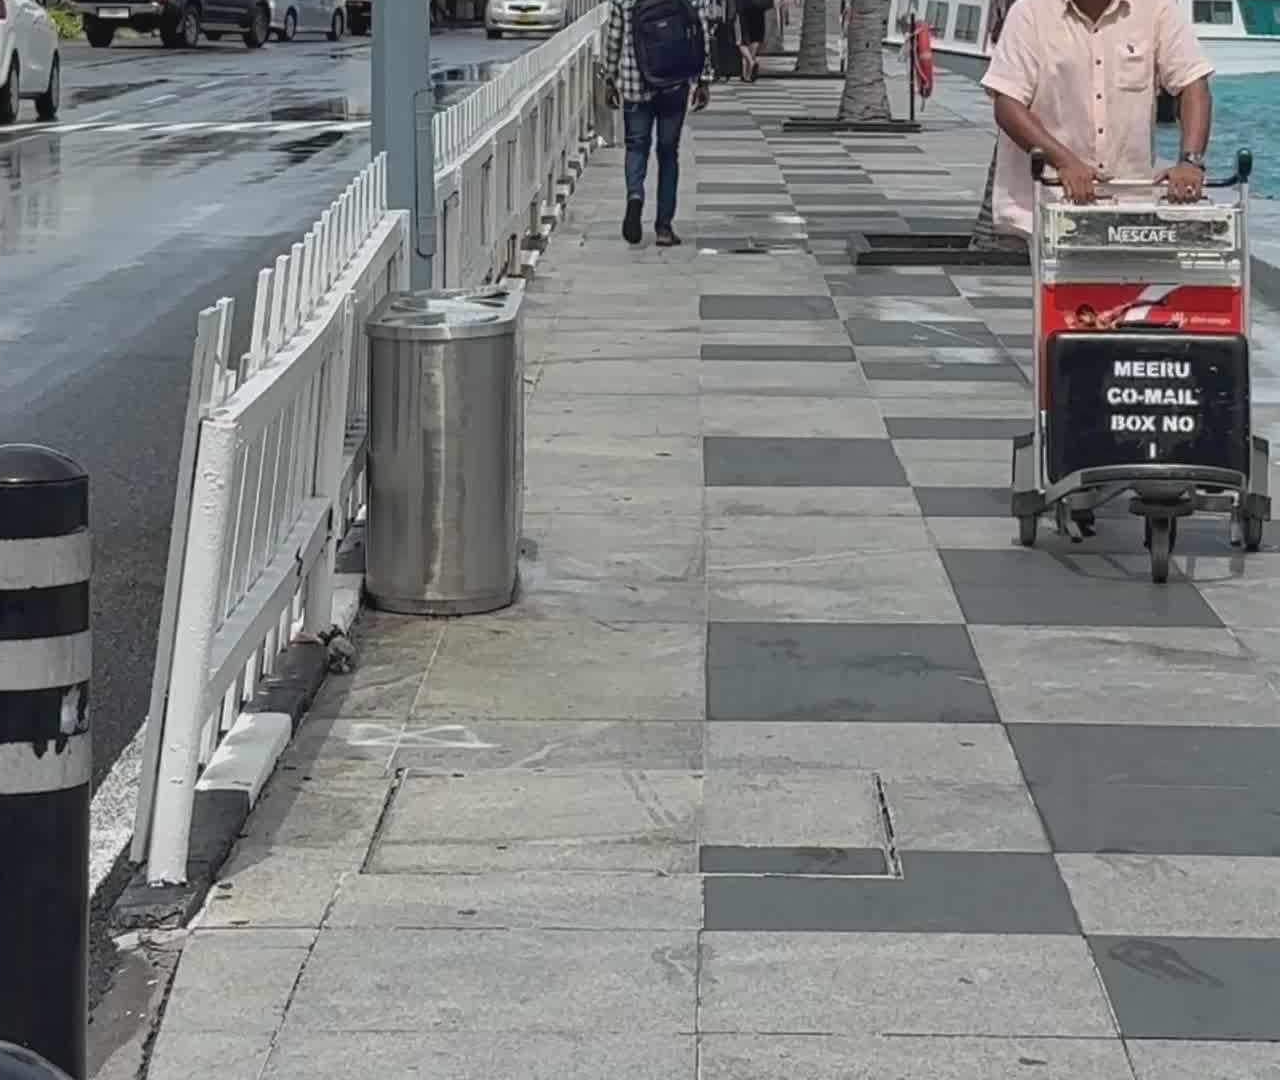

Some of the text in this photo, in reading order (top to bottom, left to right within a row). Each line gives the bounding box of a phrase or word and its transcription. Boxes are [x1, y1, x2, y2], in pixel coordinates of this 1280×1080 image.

[1113, 360, 1191, 378] MEERU
[1106, 387, 1199, 406] CO-MAIL
[1110, 415, 1195, 433] BOX NO
